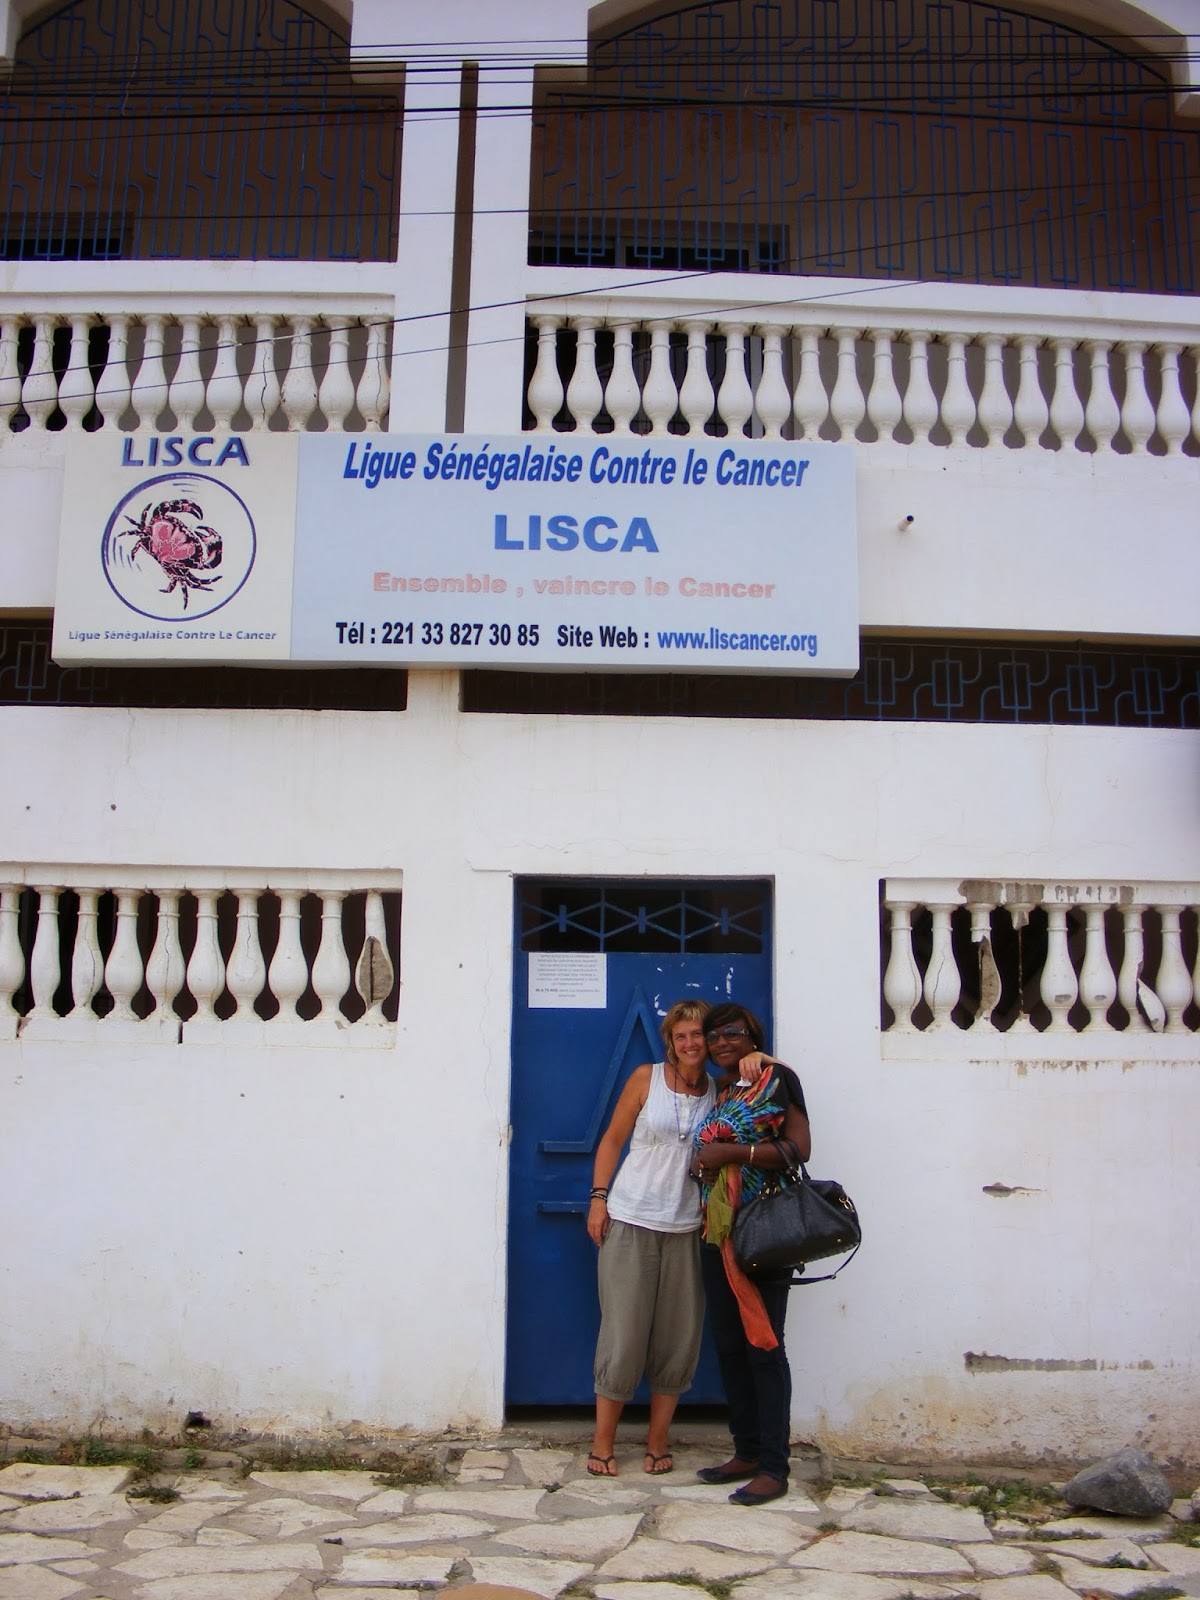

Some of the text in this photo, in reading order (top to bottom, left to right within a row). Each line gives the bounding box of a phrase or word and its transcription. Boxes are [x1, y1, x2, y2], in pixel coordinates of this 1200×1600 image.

[121, 436, 250, 467] LISCA
[342, 441, 810, 491] Ligue Sénégalaise Contre le Cancer
[494, 513, 660, 553] LISCA
[372, 571, 508, 594] Ensemble
[533, 575, 637, 596] vaincre
[645, 576, 670, 597] le
[678, 576, 776, 599] Cancer
[68, 630, 101, 643] Ligue
[175, 630, 216, 640] Contre
[218, 630, 233, 640] Le
[235, 630, 277, 640] Cancer
[335, 621, 365, 645] Tél
[381, 621, 414, 645] 221
[421, 622, 444, 646] 33
[449, 622, 484, 646] 827
[488, 623, 512, 646] 30
[517, 623, 540, 647] 85
[556, 624, 594, 648] Site
[598, 625, 639, 649] Web
[656, 626, 818, 658] www.liscancer.org
